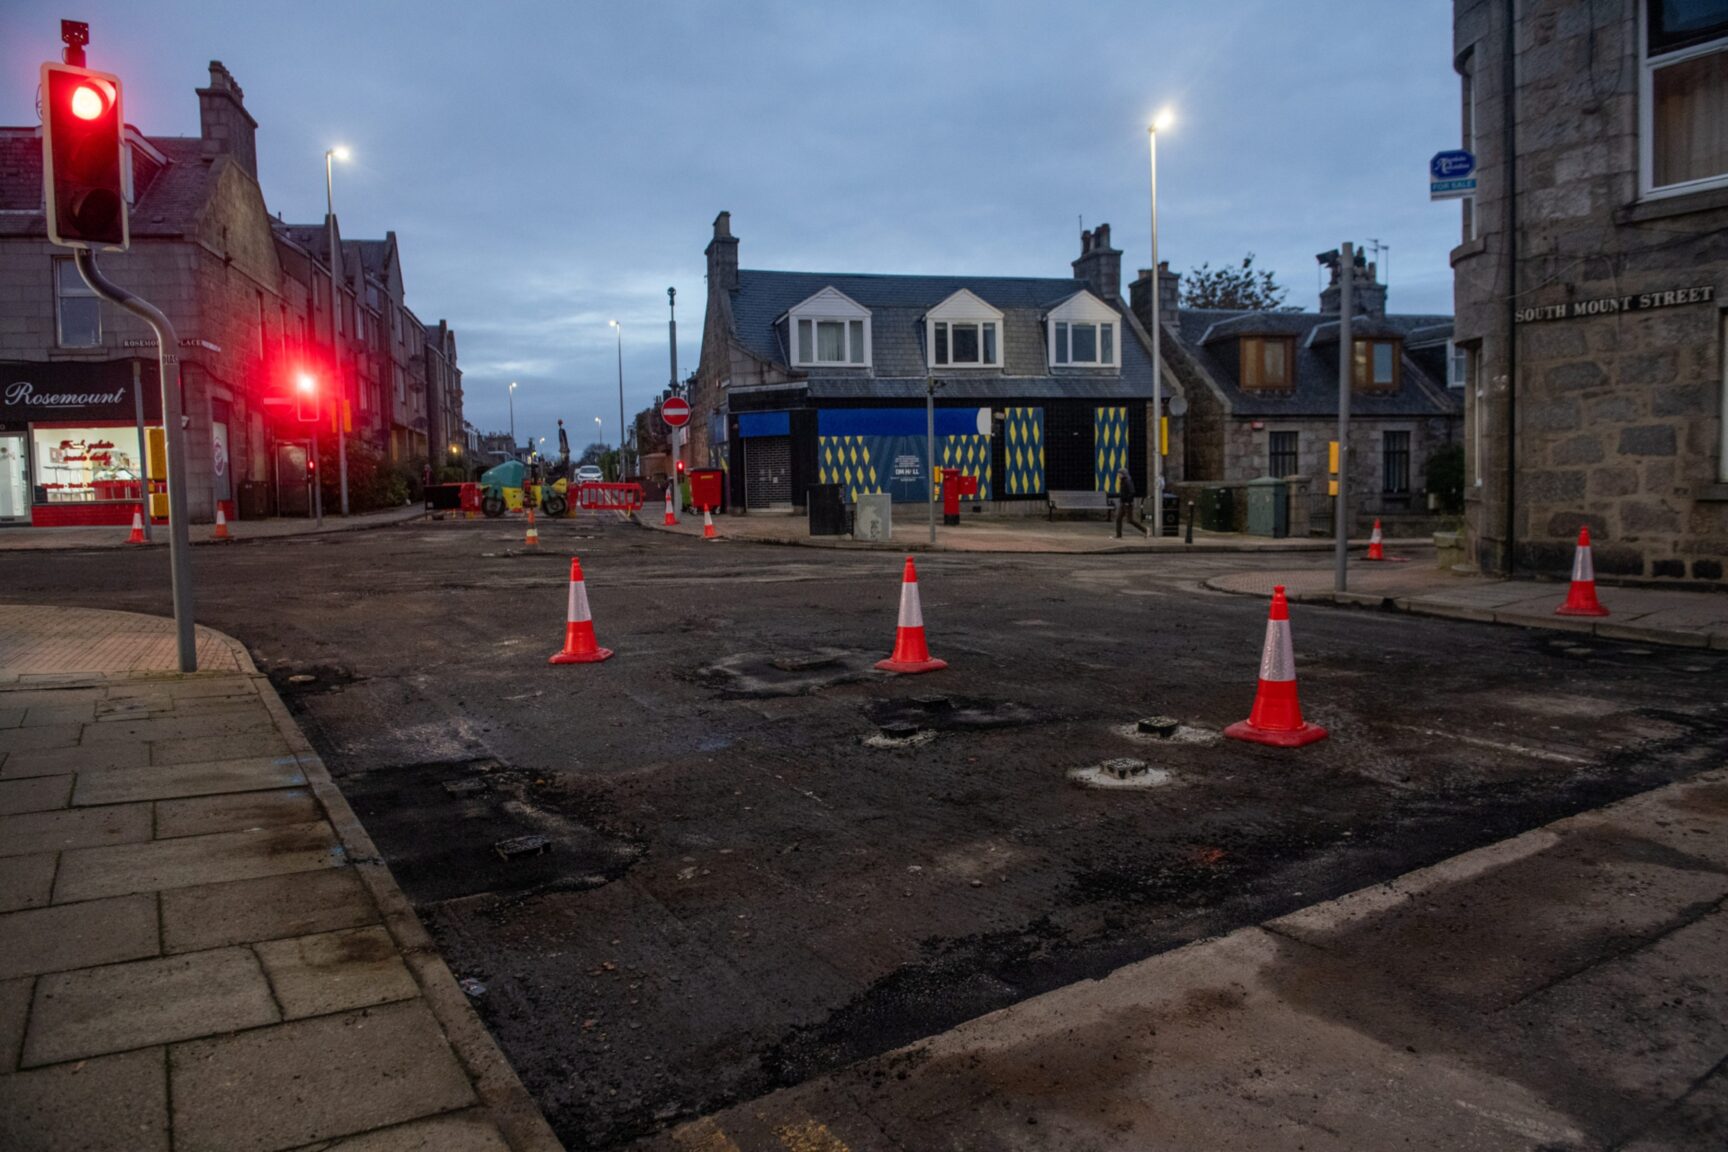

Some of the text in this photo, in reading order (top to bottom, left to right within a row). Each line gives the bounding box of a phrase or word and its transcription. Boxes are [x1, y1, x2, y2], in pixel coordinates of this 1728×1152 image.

[1515, 286, 1714, 323] SOUTH MOUNT STREET
[5, 382, 126, 405] Rosemount
